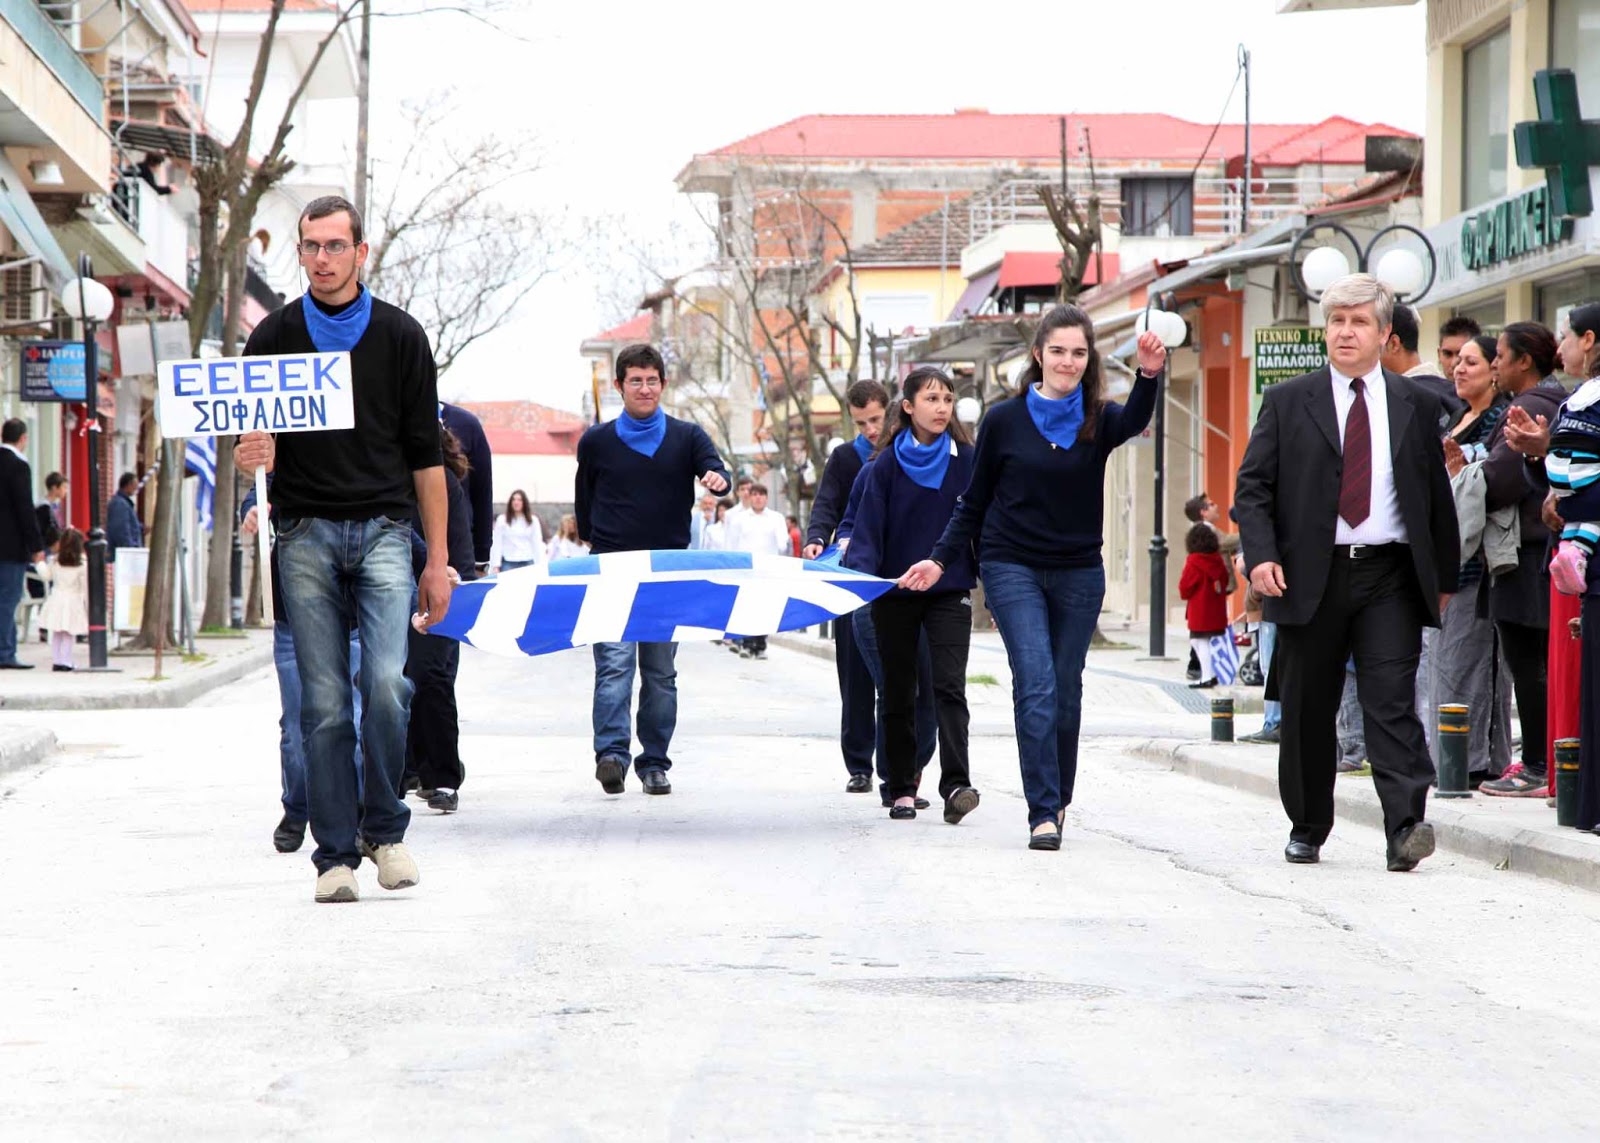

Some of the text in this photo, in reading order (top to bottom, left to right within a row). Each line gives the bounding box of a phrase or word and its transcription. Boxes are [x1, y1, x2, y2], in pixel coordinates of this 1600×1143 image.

[1256, 330, 1301, 343] ΤΕΧΝΙΚΟ
[1260, 343, 1321, 354] ΕΥΑΓΓΕΛΟΣ
[173, 357, 341, 396] ΕΕΕΕΚ
[192, 395, 327, 432] ΣΟΦΑΔΩΝ
